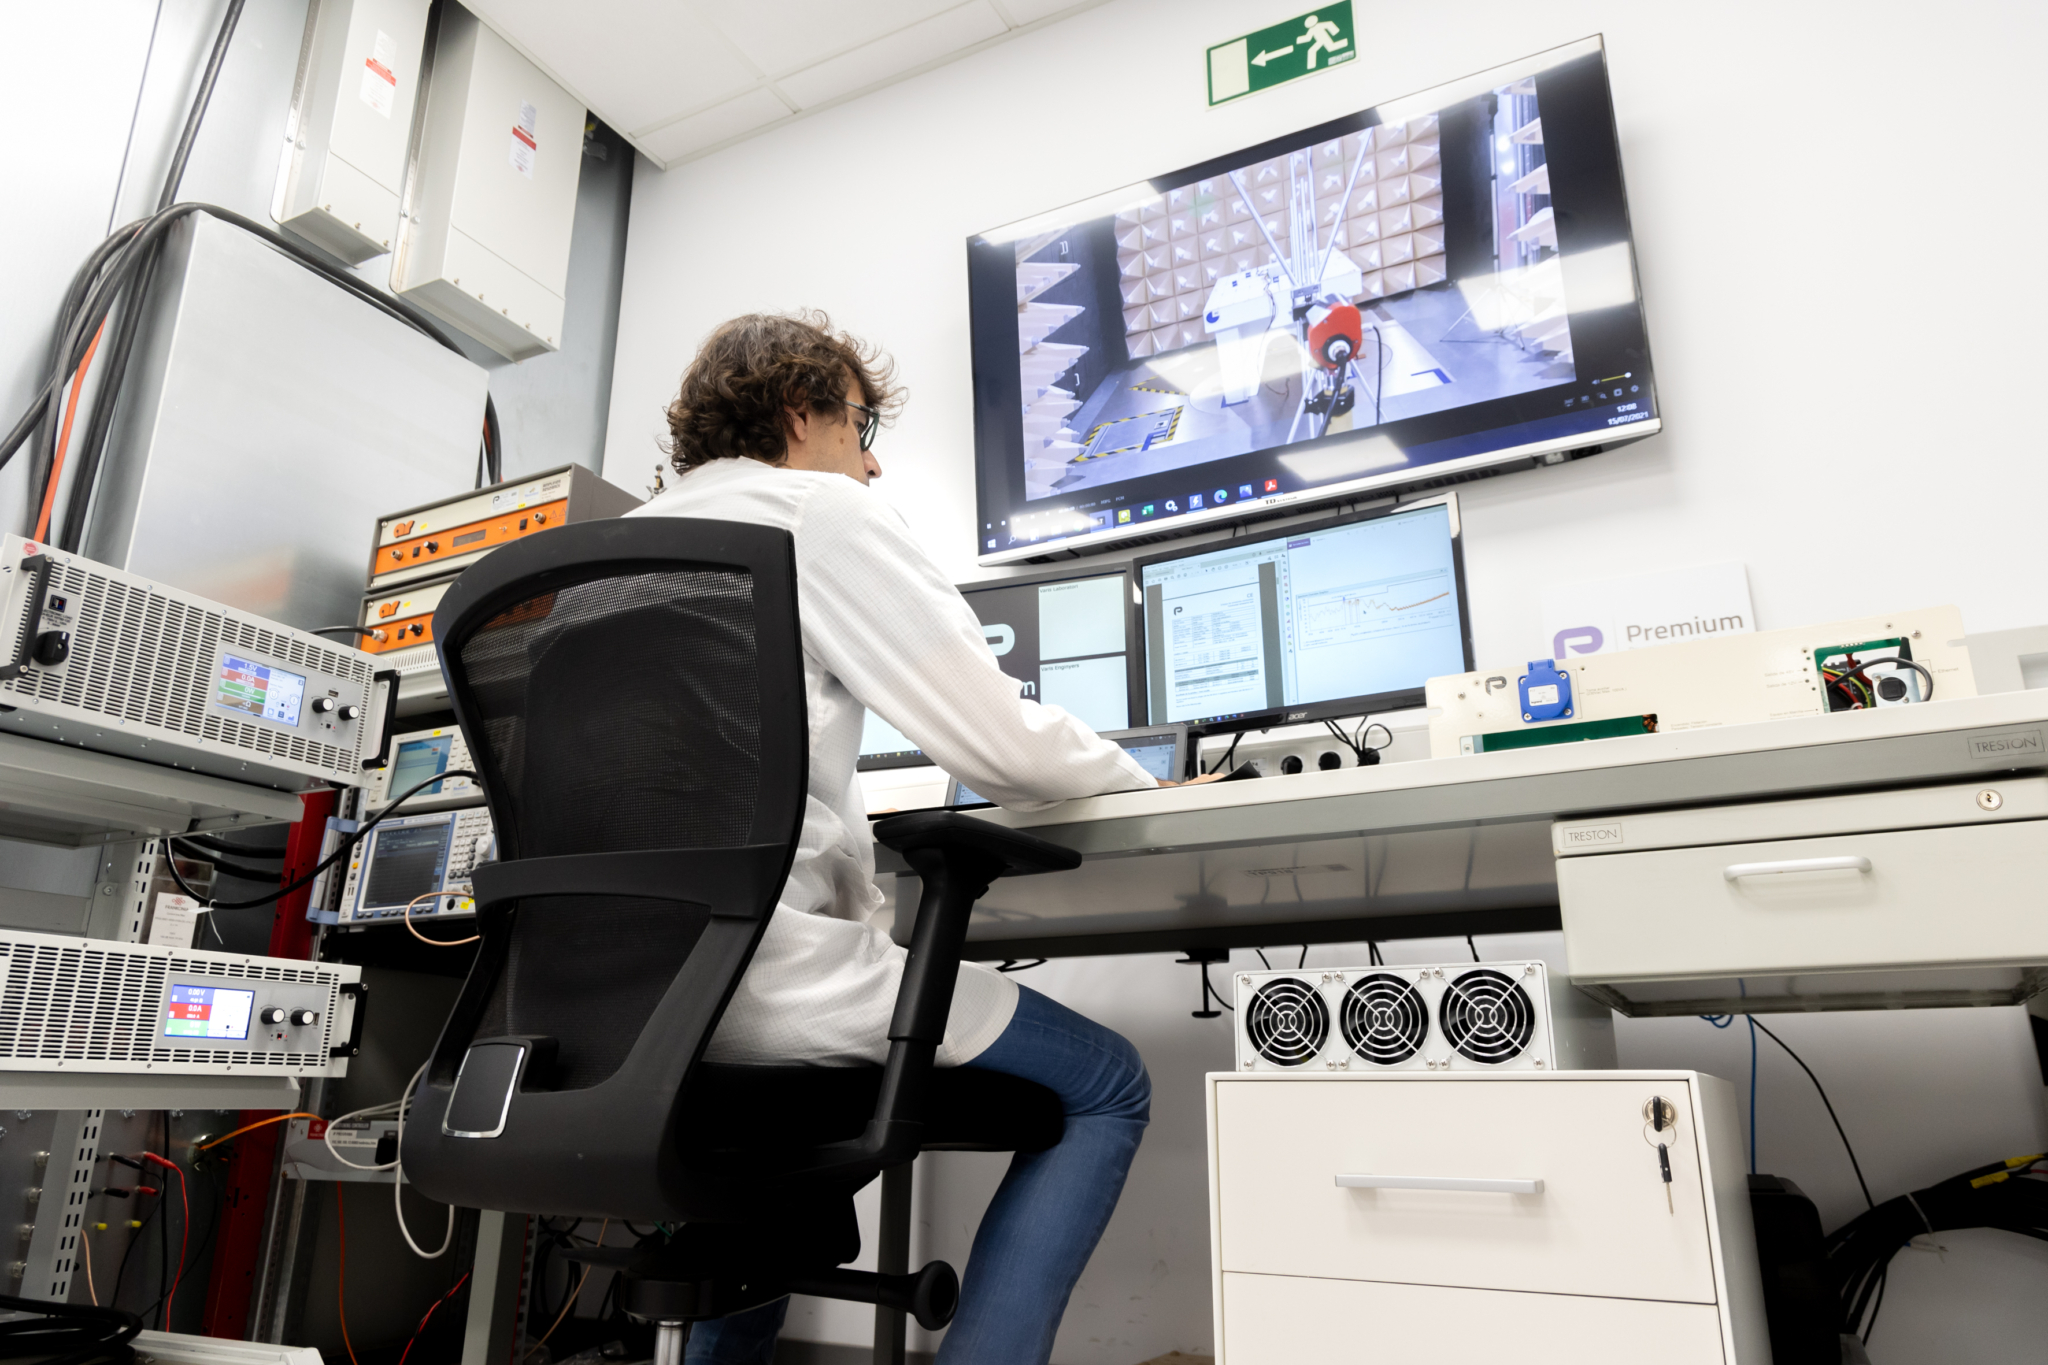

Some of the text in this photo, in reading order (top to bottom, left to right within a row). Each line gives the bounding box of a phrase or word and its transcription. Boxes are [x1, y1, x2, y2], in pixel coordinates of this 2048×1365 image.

[1626, 615, 1744, 642] Premium
[1288, 712, 1308, 720] acer
[1975, 736, 2037, 753] TRESTON
[1568, 829, 1617, 842] TRESTON
